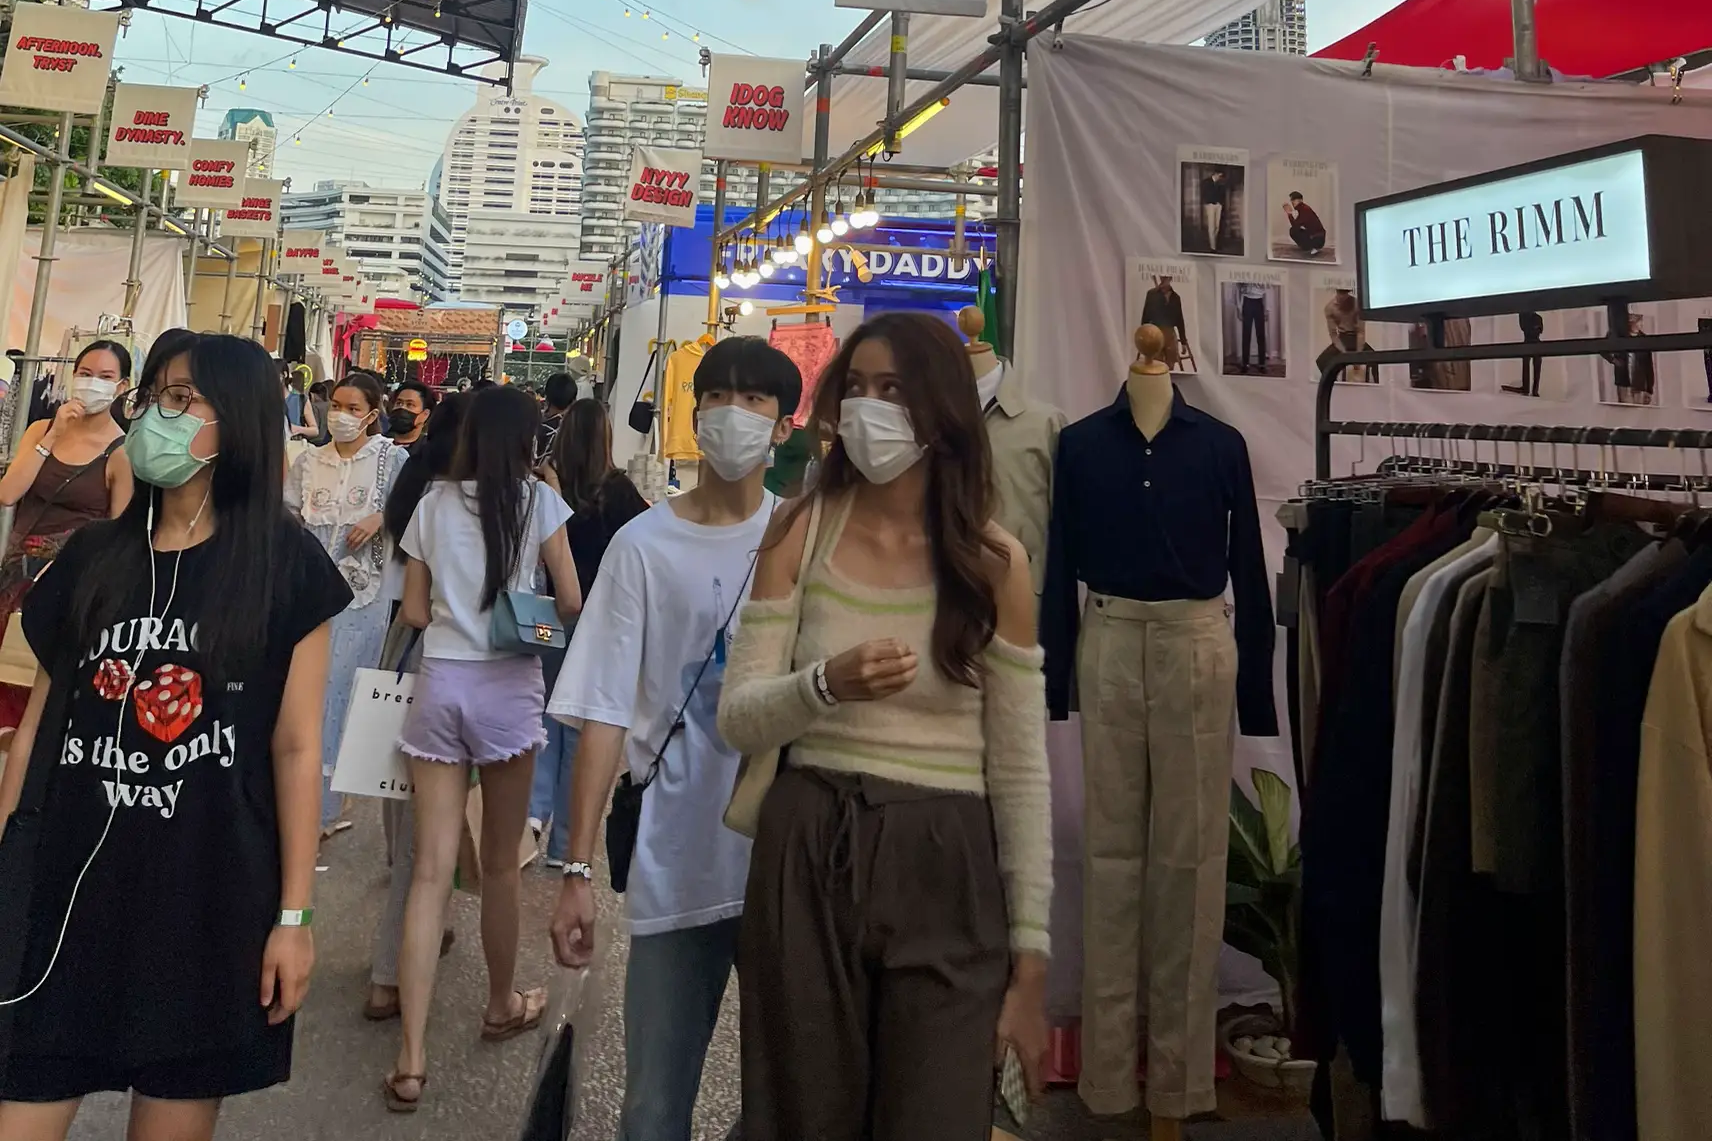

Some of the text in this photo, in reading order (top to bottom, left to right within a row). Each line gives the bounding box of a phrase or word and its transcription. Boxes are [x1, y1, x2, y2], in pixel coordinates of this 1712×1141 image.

[16, 36, 102, 58] AFTERNOON.
[33, 55, 77, 72] TRYST
[730, 83, 785, 108] IDOG
[133, 111, 170, 126] DIME
[723, 106, 789, 131] KNOW
[115, 127, 186, 146] DYNASTY.
[192, 160, 236, 173] COMFY
[188, 174, 235, 188] HOMIES
[640, 167, 690, 189] NYYY
[631, 183, 694, 207] DESIGN
[1403, 191, 1607, 268] THE RIMM
[371, 688, 415, 705] brea
[92, 736, 150, 774] the
[163, 720, 236, 771] only
[102, 779, 184, 819] way
